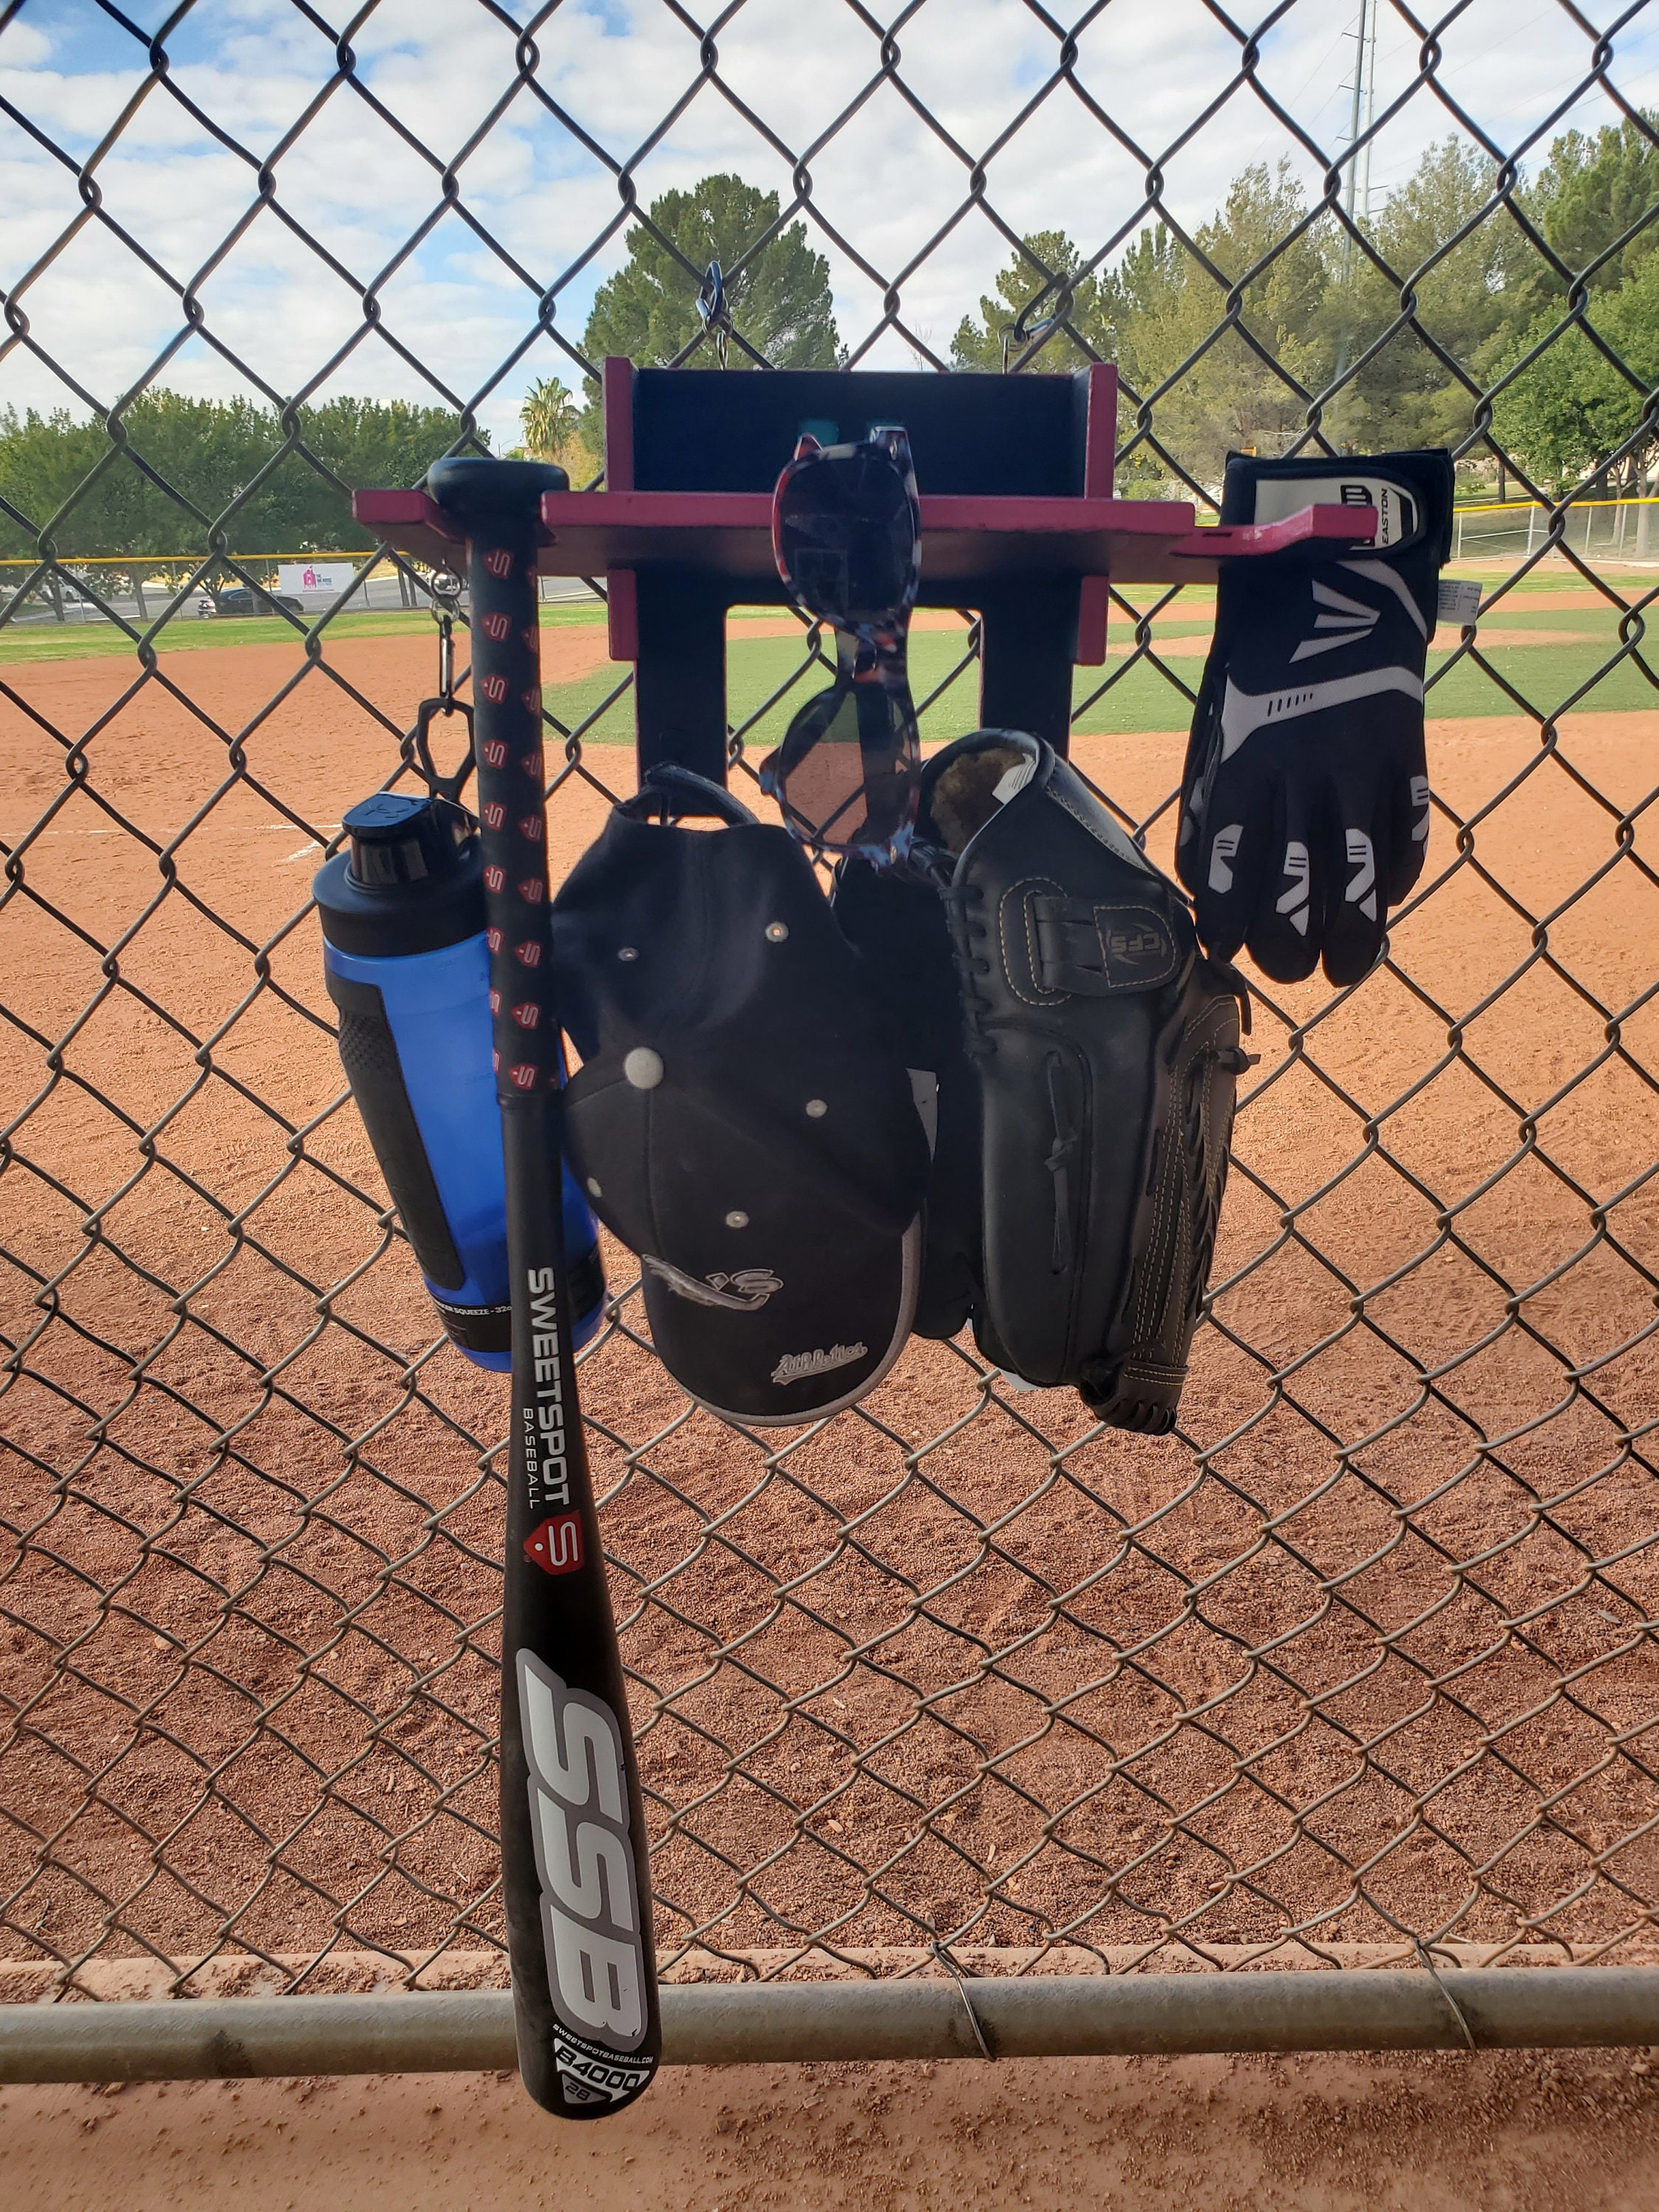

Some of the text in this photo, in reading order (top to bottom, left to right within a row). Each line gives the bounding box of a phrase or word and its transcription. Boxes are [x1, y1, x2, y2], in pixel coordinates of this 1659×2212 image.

[1381, 488, 1389, 545] EASTON
[453, 1307, 490, 1316] SQUEEZE
[528, 1267, 570, 1506] SWEETSPOT
[524, 1408, 540, 1509] BASEBALL
[522, 1660, 644, 2039] SSB
[552, 2023, 653, 2064] SWEETSPOTBASEBALL.COM
[556, 2045, 641, 2092] B4000
[565, 2081, 591, 2101] 28
